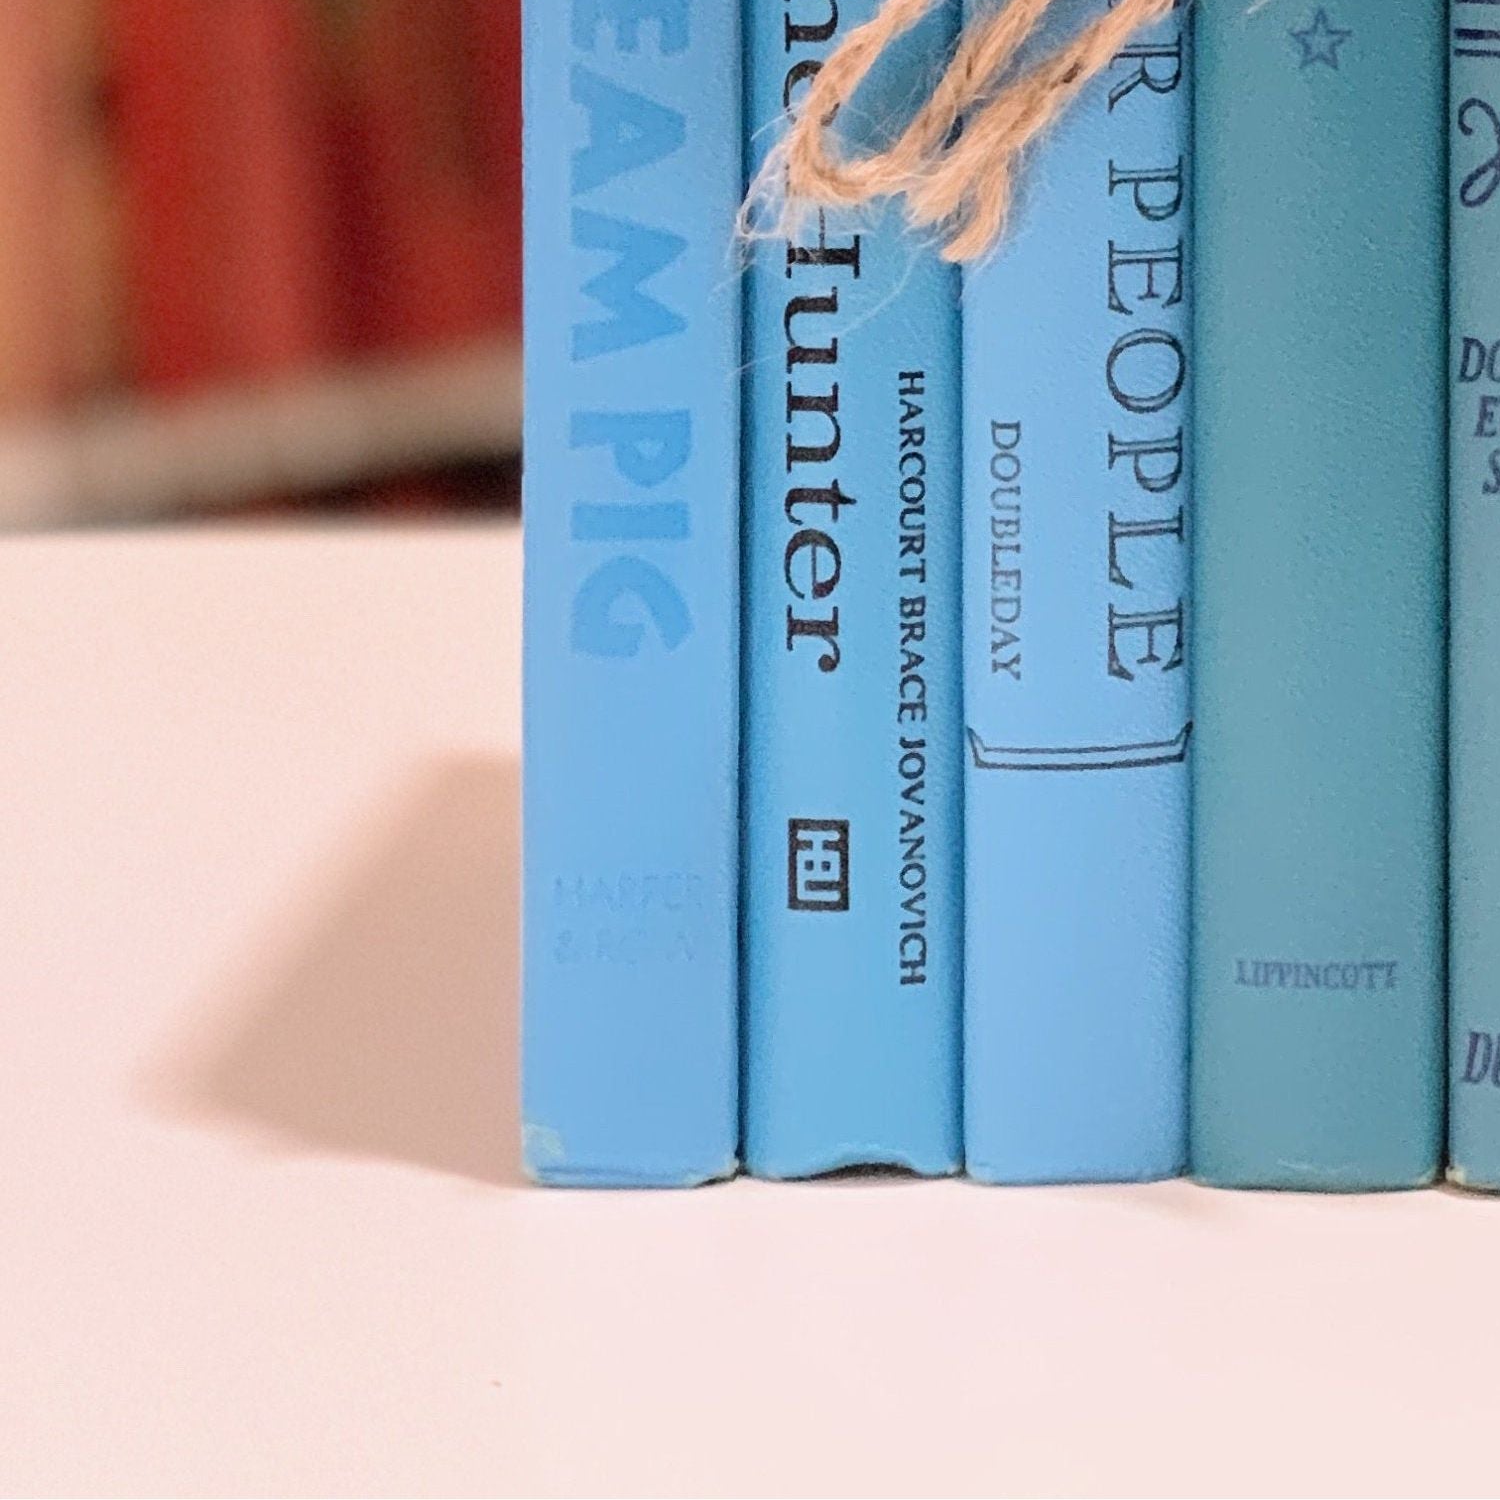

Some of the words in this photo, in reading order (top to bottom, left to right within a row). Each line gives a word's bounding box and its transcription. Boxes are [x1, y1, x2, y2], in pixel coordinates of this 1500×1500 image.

[569, 407, 696, 660] PIG
[783, 164, 862, 674] Hunter
[897, 368, 927, 584] HARCOURT
[1105, 157, 1187, 682] PEOPLE
[897, 596, 928, 724] BRACE
[989, 420, 1022, 682] DOUBLEDAY
[897, 736, 928, 986] JOVANOVICH
[1234, 959, 1399, 990] LIPPINCOTT
